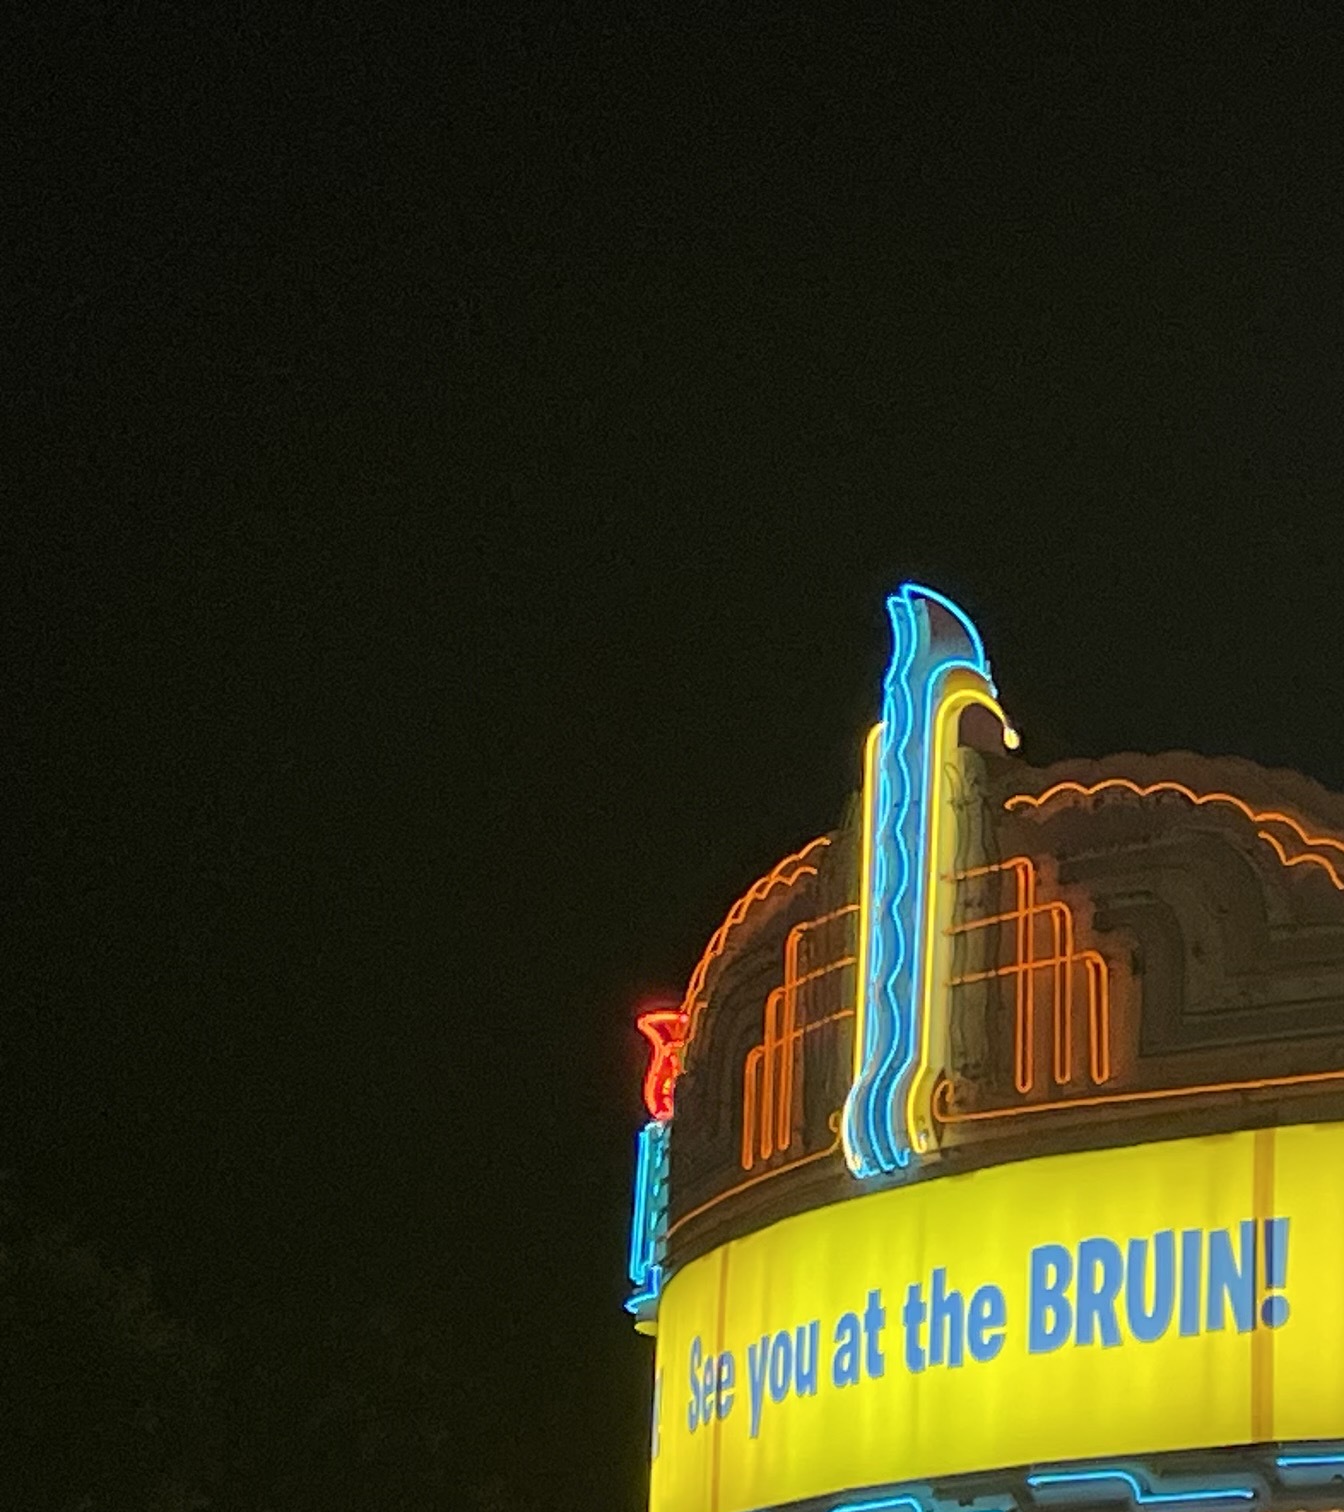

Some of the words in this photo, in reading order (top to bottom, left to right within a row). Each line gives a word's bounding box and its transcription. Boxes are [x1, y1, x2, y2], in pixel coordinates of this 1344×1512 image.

[688, 1335, 735, 1434] See
[748, 1319, 820, 1439] you
[832, 1289, 886, 1388] at
[902, 1267, 1007, 1374] the
[1028, 1217, 1291, 1354] BRUIN!
